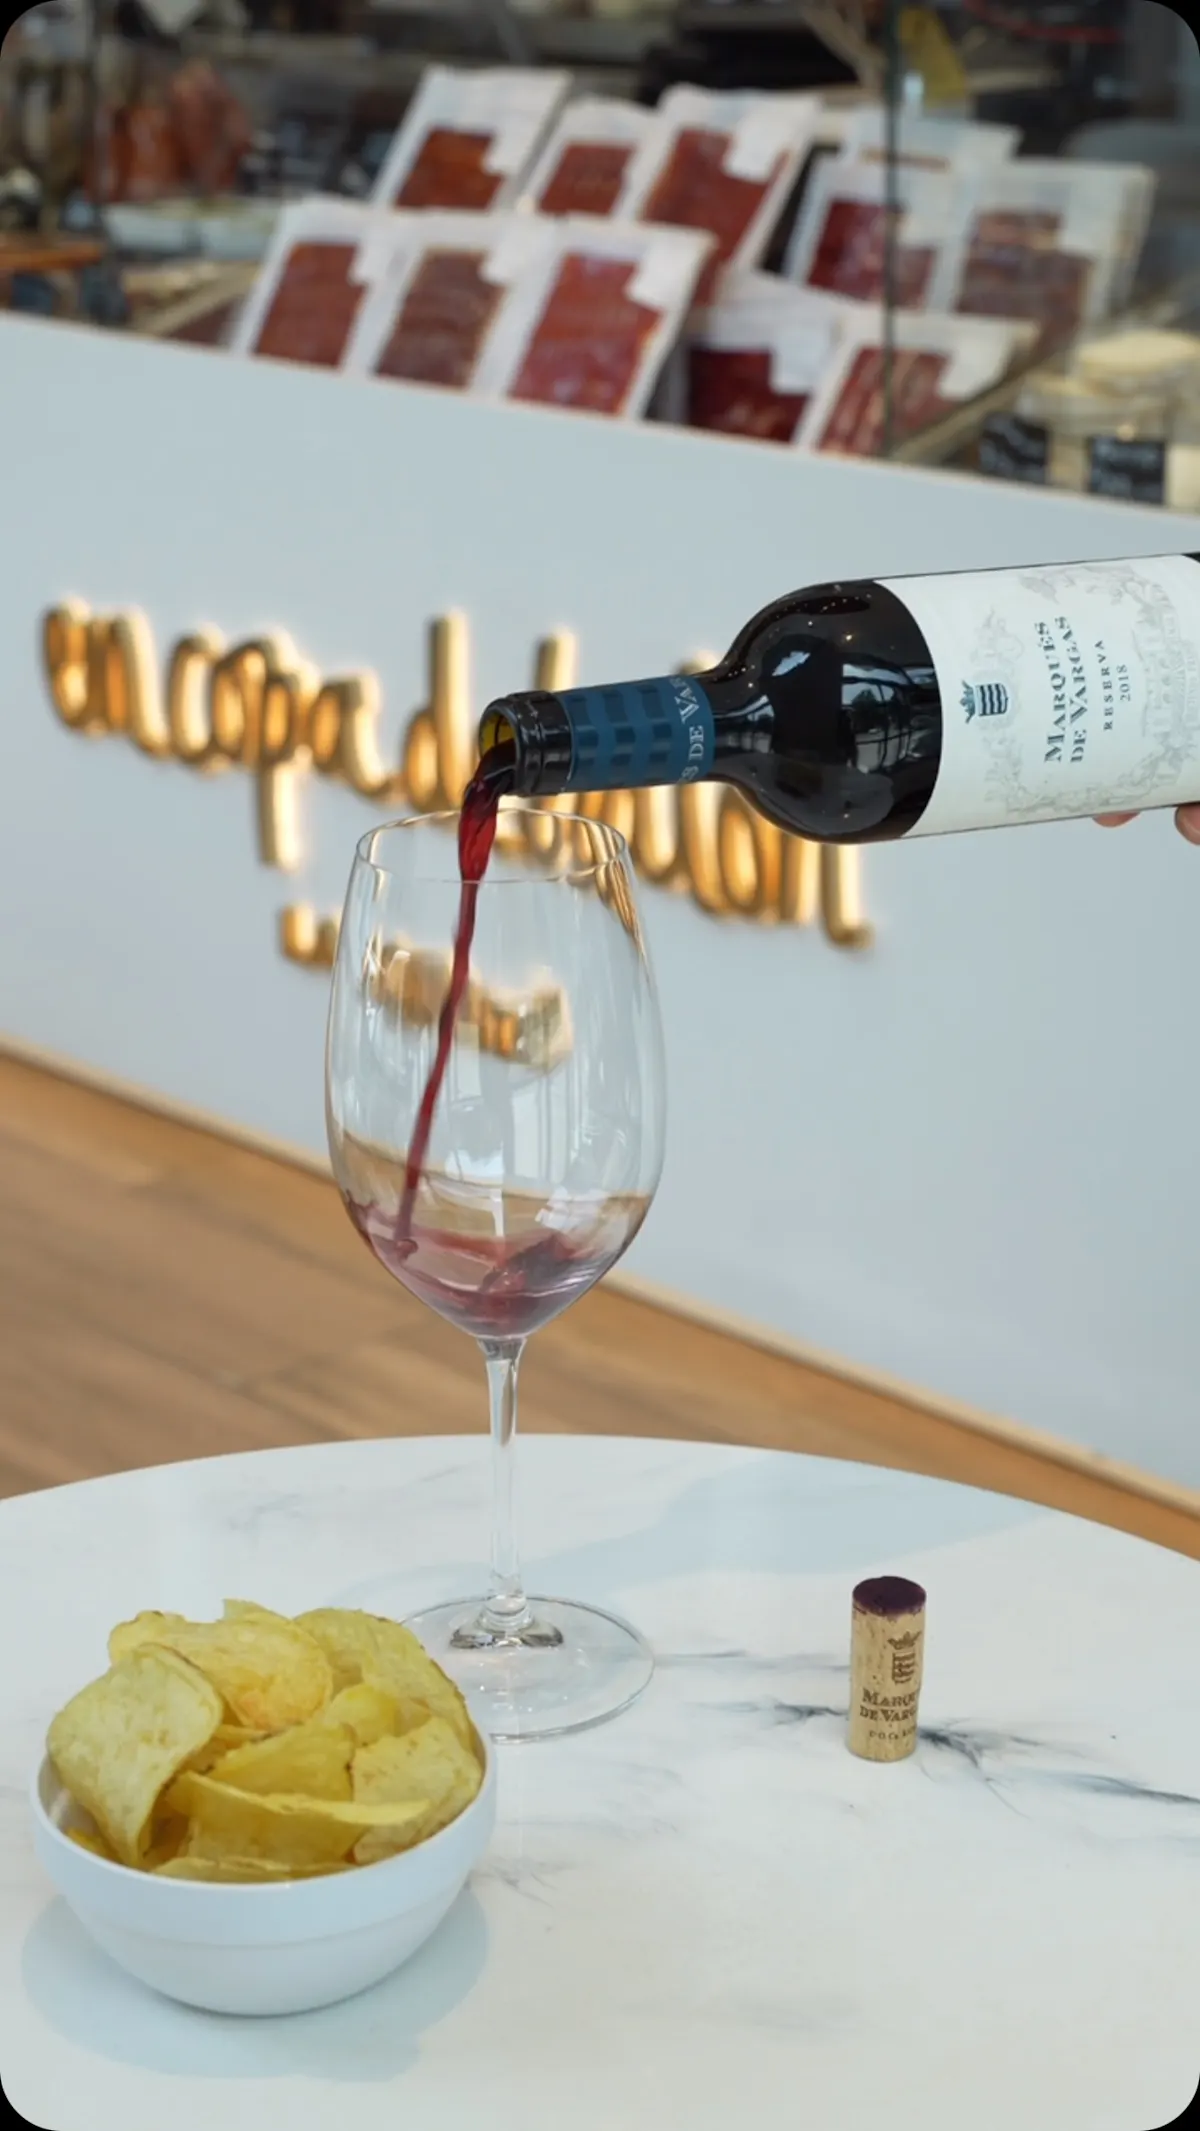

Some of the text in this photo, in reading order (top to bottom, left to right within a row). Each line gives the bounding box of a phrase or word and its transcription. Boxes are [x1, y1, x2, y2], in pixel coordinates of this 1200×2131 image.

[1033, 621, 1067, 763] MARQUÉS
[1054, 615, 1089, 763] DE VARGAS
[1093, 639, 1115, 732] RESERVA
[1115, 663, 1132, 702] 2018
[688, 724, 705, 762] DE
[860, 1704, 878, 1721] DE
